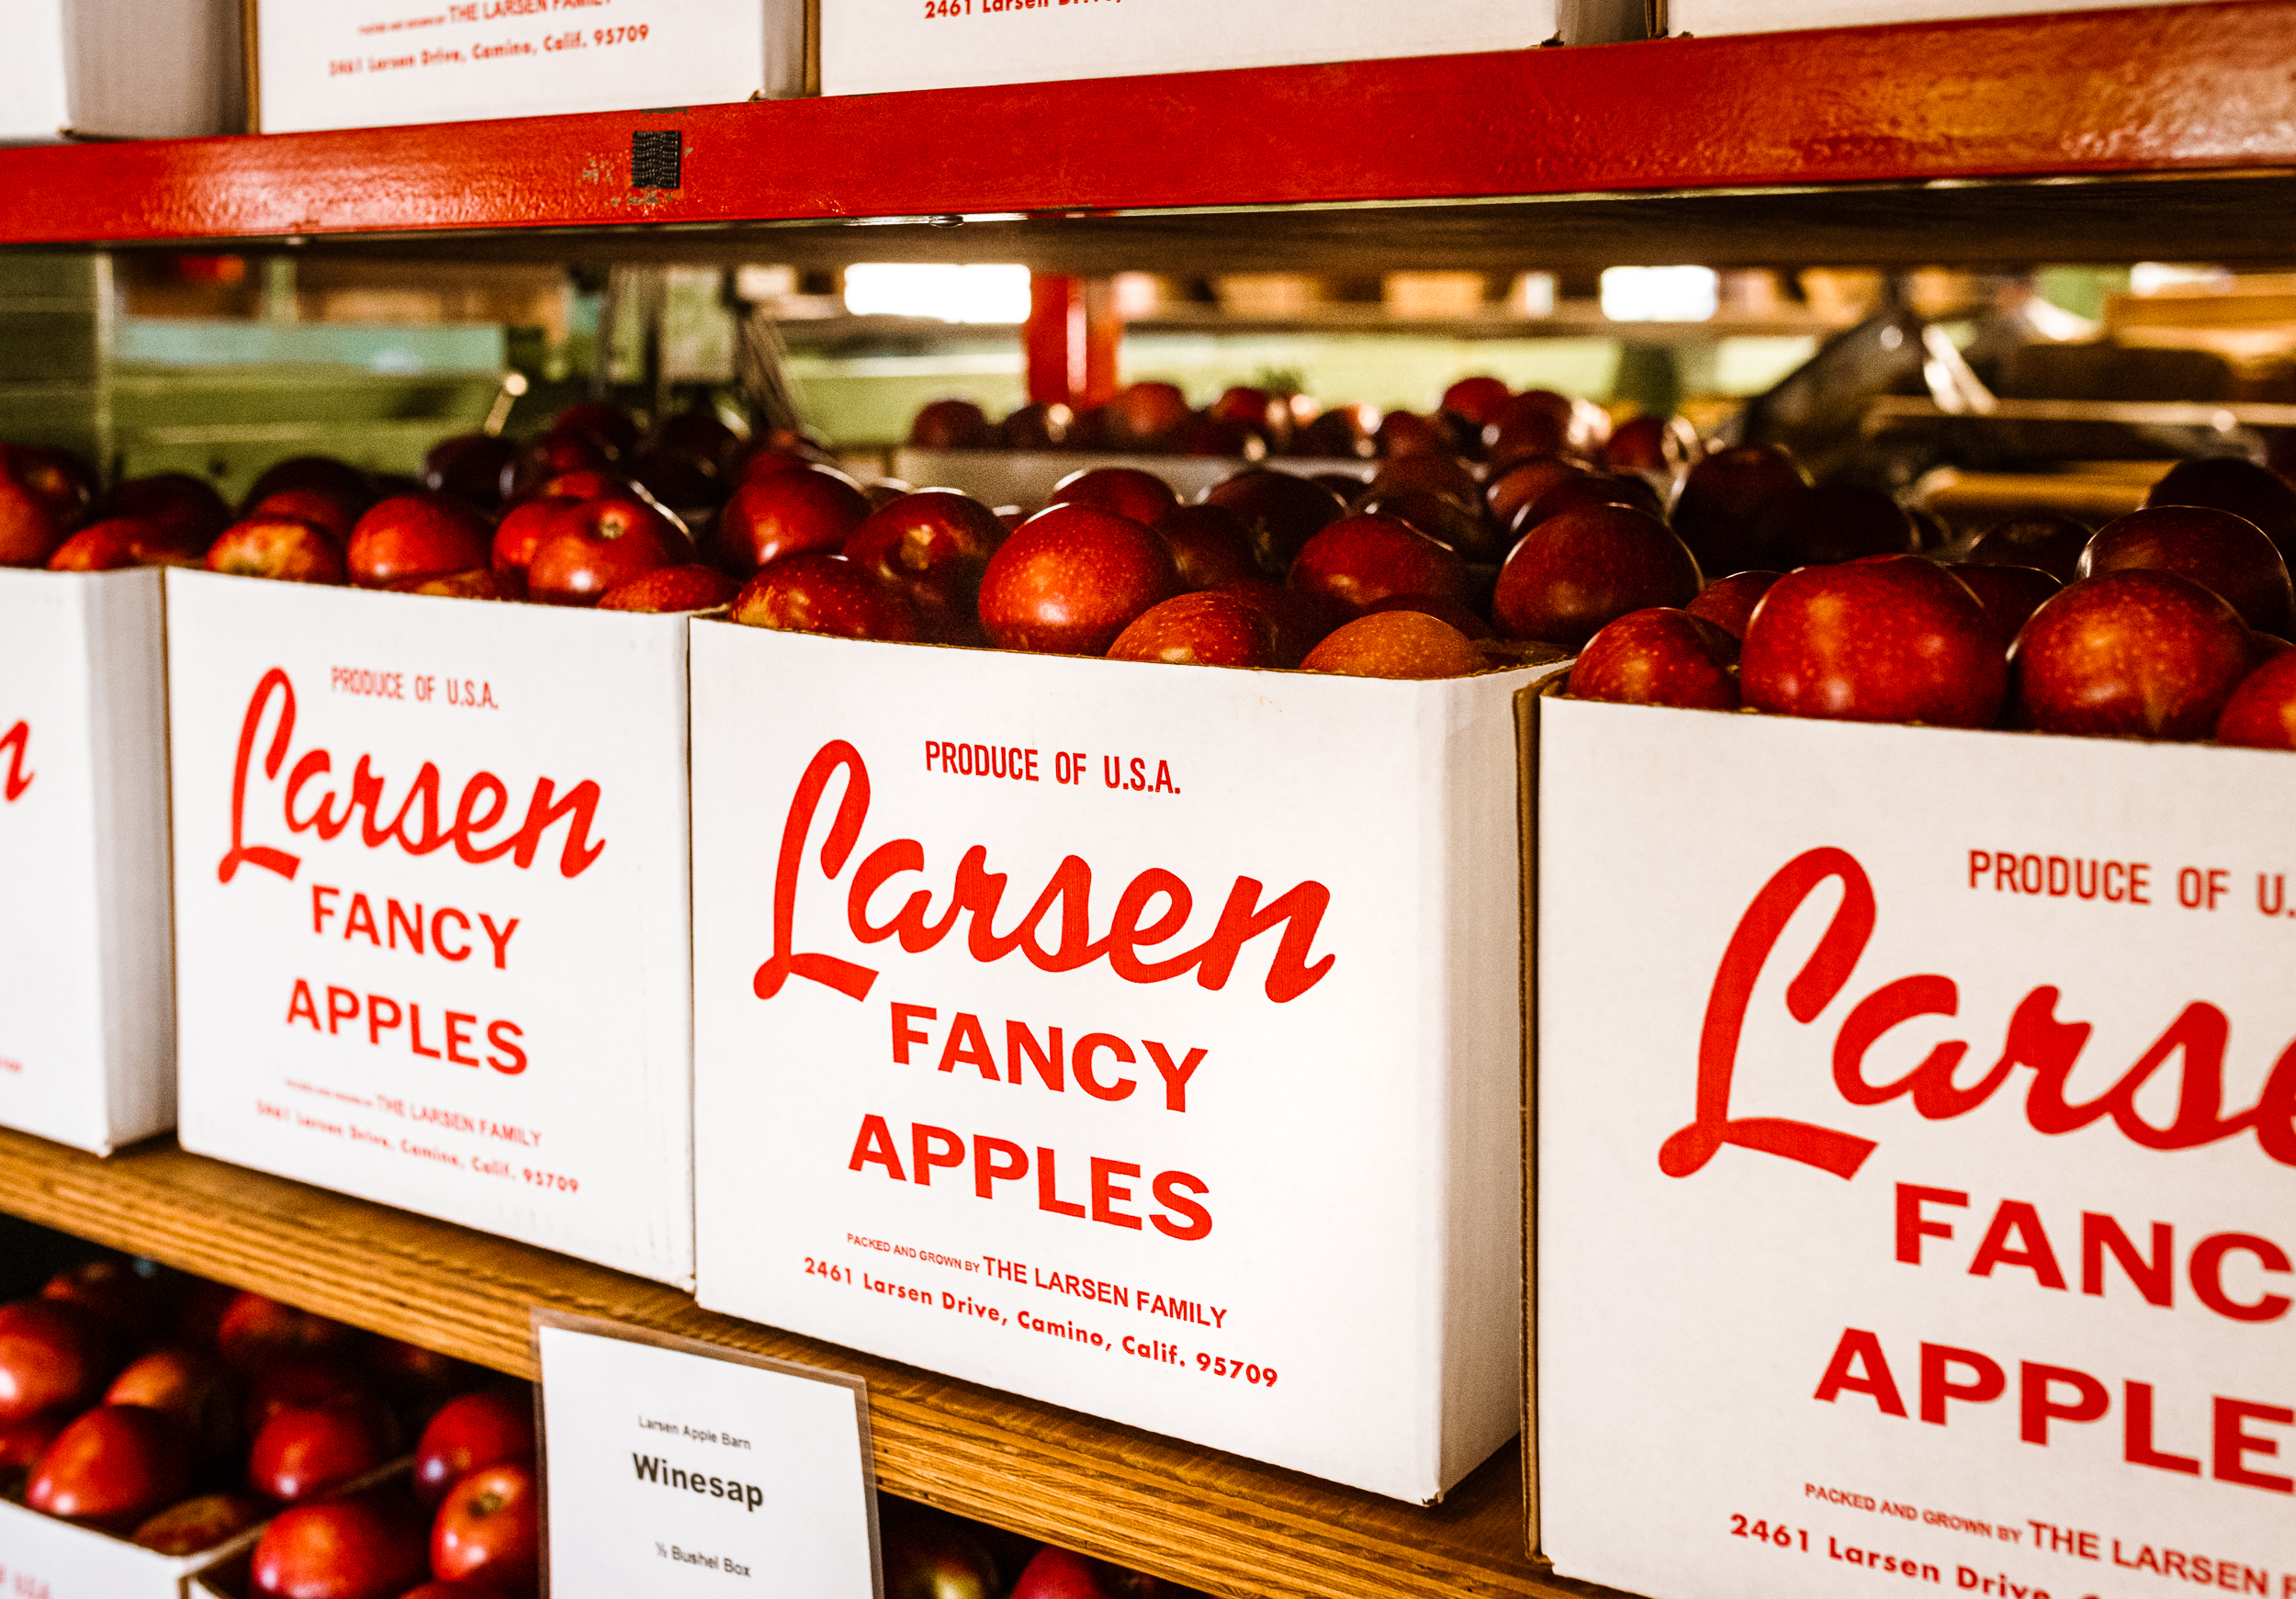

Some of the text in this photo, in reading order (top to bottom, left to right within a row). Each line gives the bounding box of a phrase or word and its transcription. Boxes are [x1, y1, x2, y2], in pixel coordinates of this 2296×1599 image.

[593, 24, 649, 45] 95709
[925, 0, 971, 18] 2461
[332, 666, 499, 710] PRODUCE OF U.S.A.
[217, 667, 606, 884] Larsen
[926, 740, 1180, 794] PRODUCE OF U.S.A.
[753, 739, 1335, 1003] Larsen
[1968, 850, 2151, 906] PRODUCE
[2178, 866, 2230, 911] OF
[311, 884, 520, 970] FANCY
[286, 978, 528, 1075] APPLES
[891, 1001, 1209, 1113] FANCY
[411, 1107, 474, 1132] LARSEN
[479, 1120, 541, 1146] FAMILY
[523, 1168, 579, 1193] 95709
[849, 1113, 1212, 1241] APPLES
[847, 1233, 1227, 1328] PACKED AND GROWN BY THE LARSEN FAMILY
[805, 1257, 1277, 1387] 2461 Larsen Drive, Camino, Calif. 95709
[638, 1415, 751, 1450] Larsen Apple Barn
[1813, 1327, 2296, 1495] APPLE
[633, 1453, 763, 1513] Winesap
[672, 1546, 718, 1568] Bushel
[724, 1558, 750, 1577] Box
[1731, 1514, 1808, 1552] 2461
[1829, 1537, 1940, 1583] Larsen
[1805, 1482, 1876, 1512] PACKED
[1880, 1500, 1919, 1521] AND
[1922, 1509, 1992, 1537] GROWN
[1997, 1526, 2022, 1543] BY
[2027, 1519, 2100, 1561] THE
[2112, 1537, 2270, 1598] LARSEN
